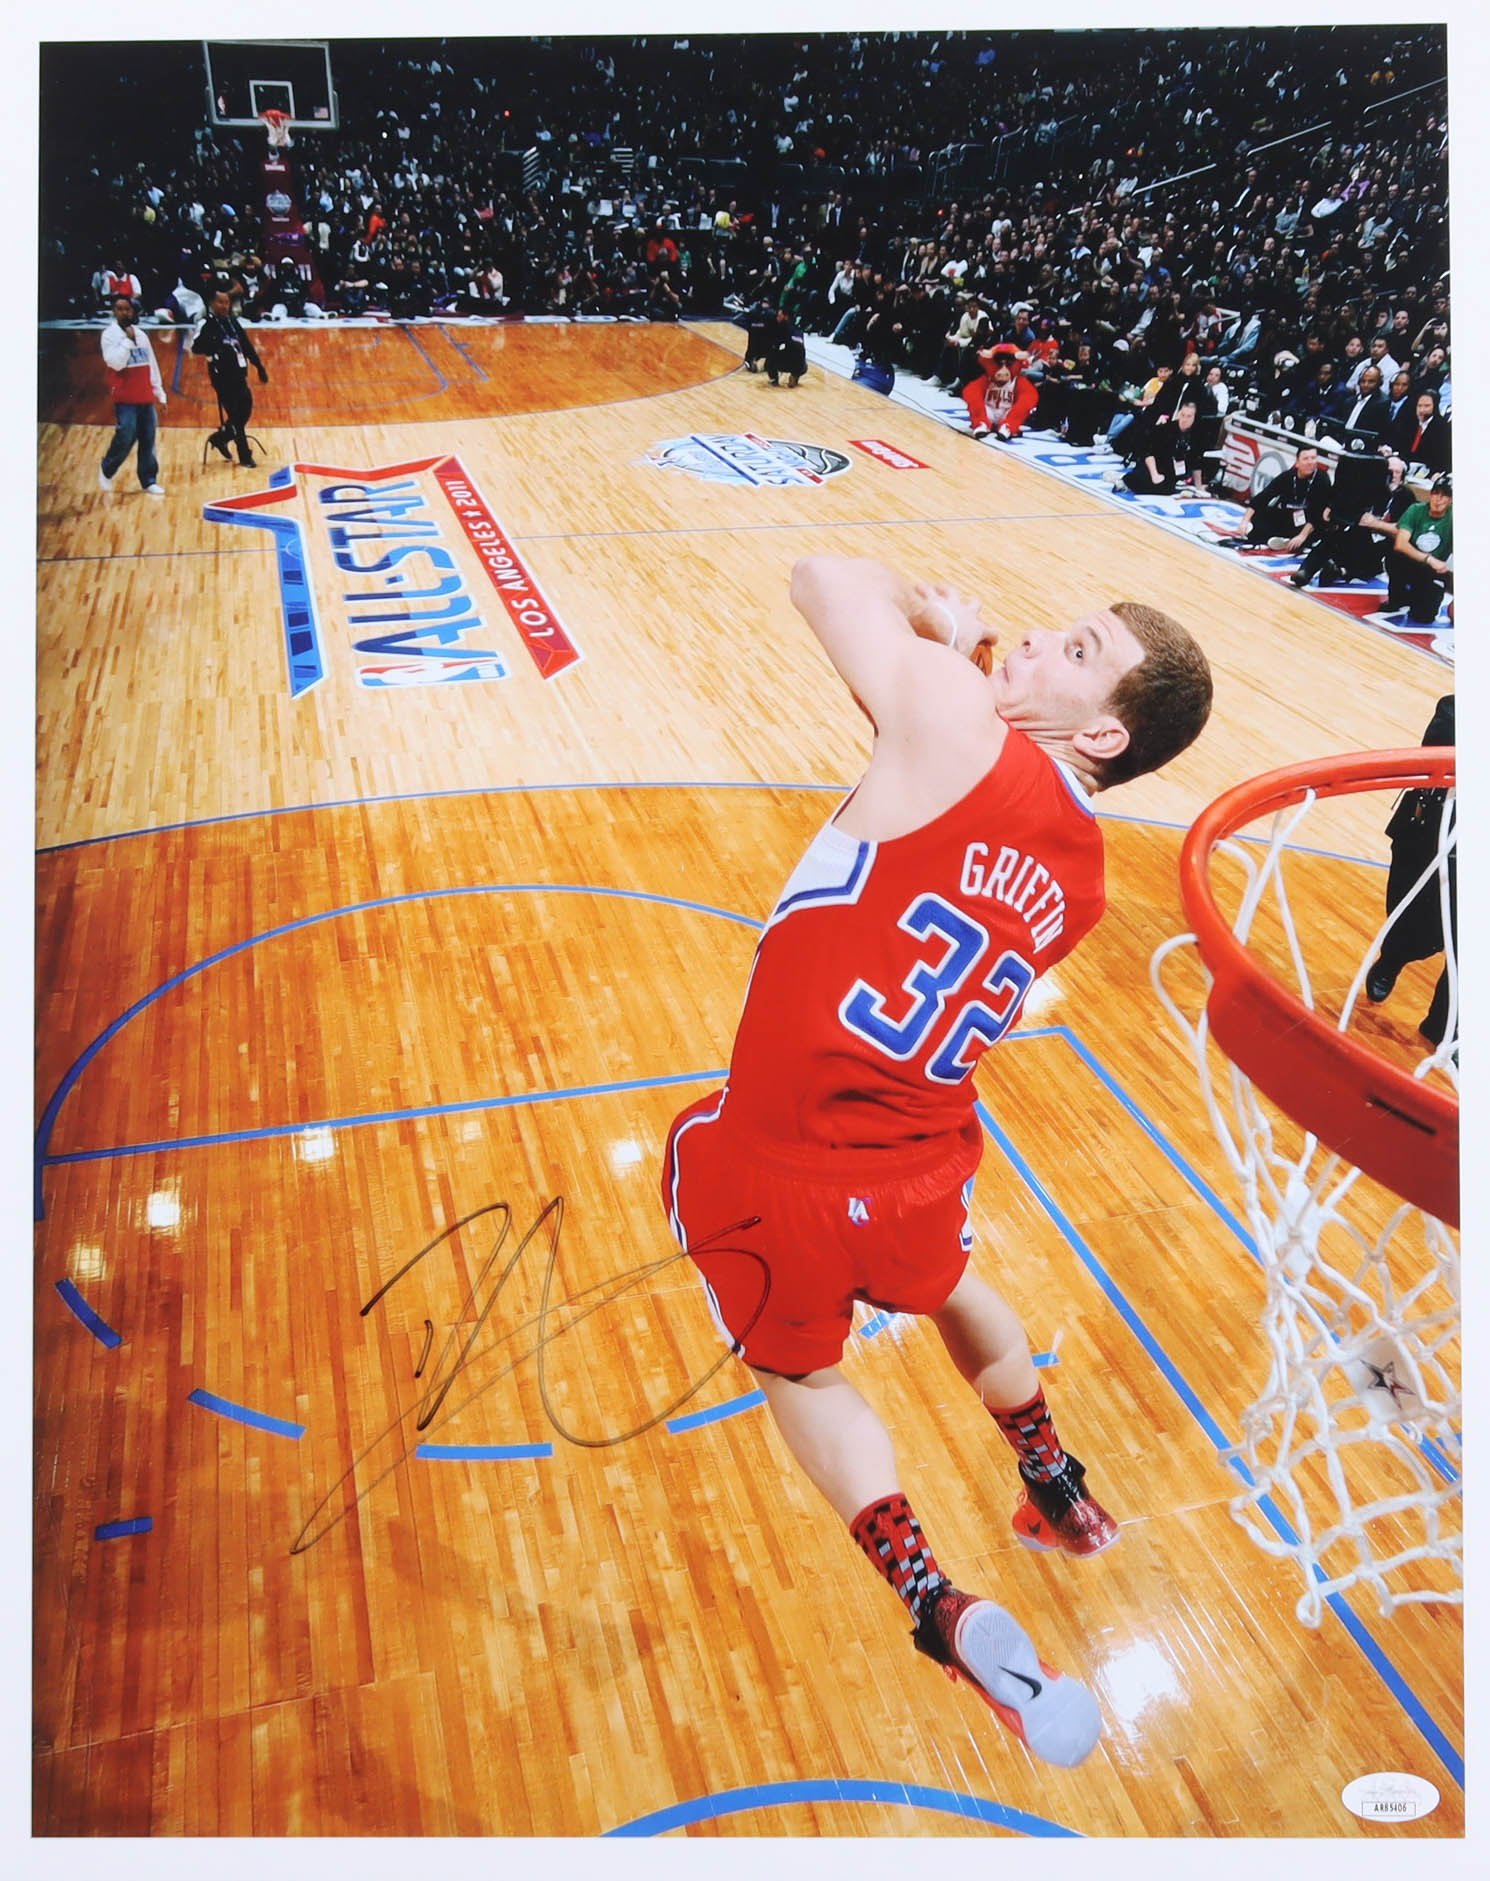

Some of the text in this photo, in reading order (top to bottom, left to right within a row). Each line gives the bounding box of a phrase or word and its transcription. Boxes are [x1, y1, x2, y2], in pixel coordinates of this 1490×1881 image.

[445, 480, 554, 638] LOS ANGELES 2011
[960, 842, 1065, 954] GRIFFIN
[838, 892, 1035, 1085] 32
